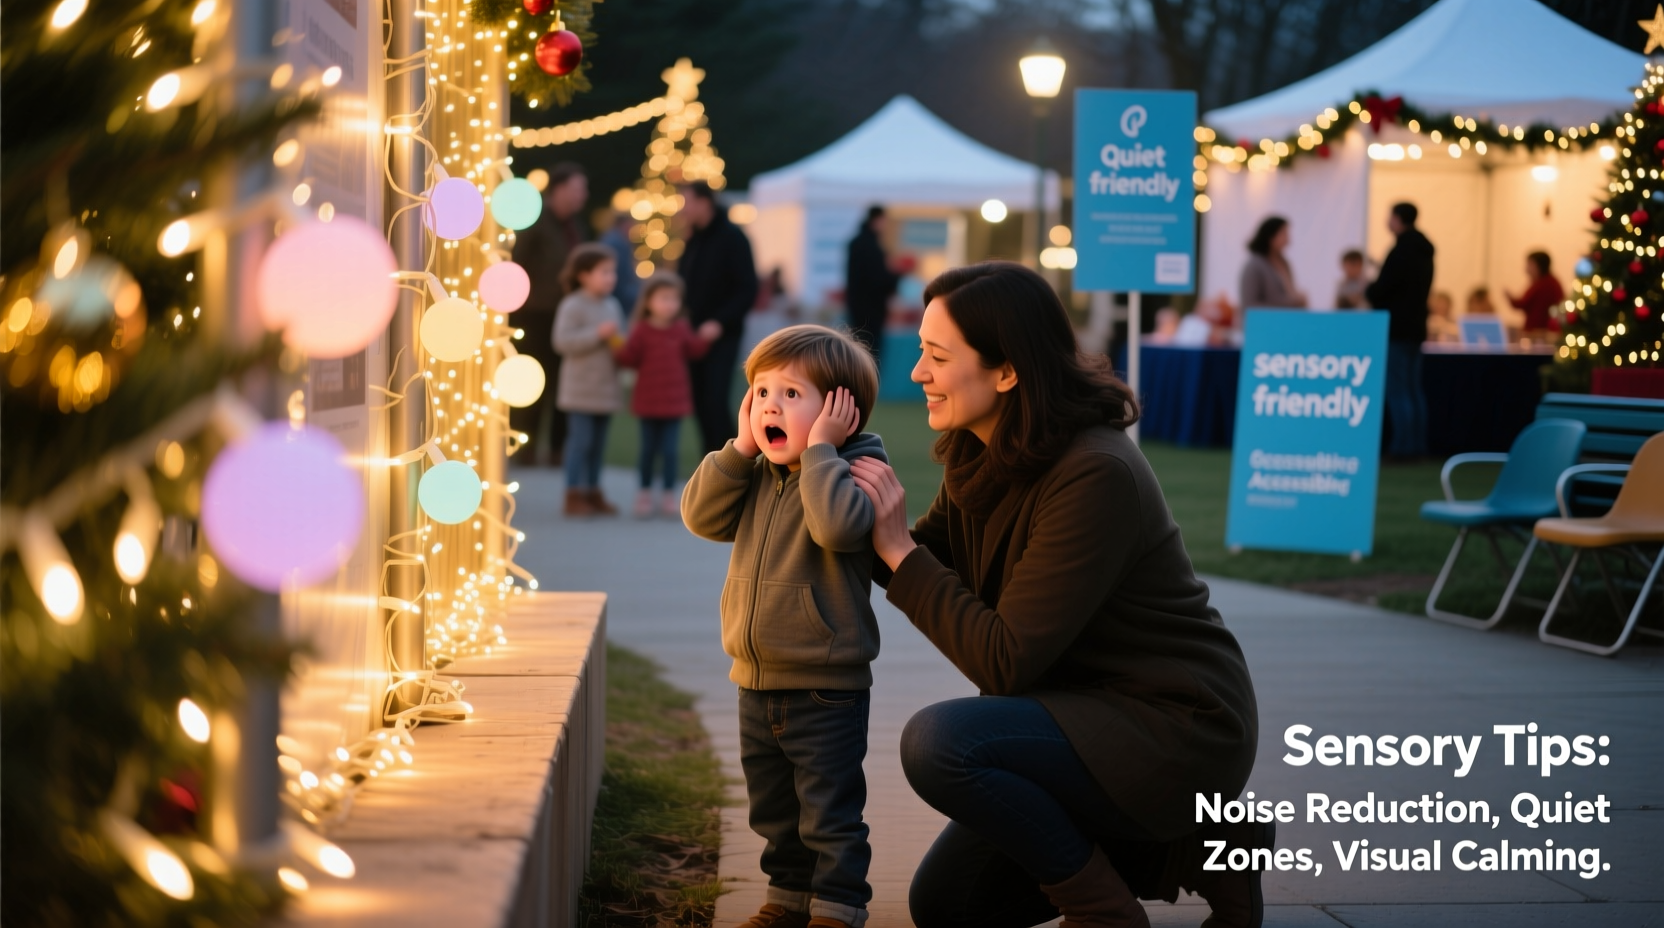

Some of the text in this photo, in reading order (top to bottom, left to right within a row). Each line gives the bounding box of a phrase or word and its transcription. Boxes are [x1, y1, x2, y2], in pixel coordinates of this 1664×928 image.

[1100, 143, 1166, 170] Quiet
[1089, 170, 1179, 202] friendly
[1253, 352, 1371, 387] sensory
[1252, 384, 1369, 427] friendly
